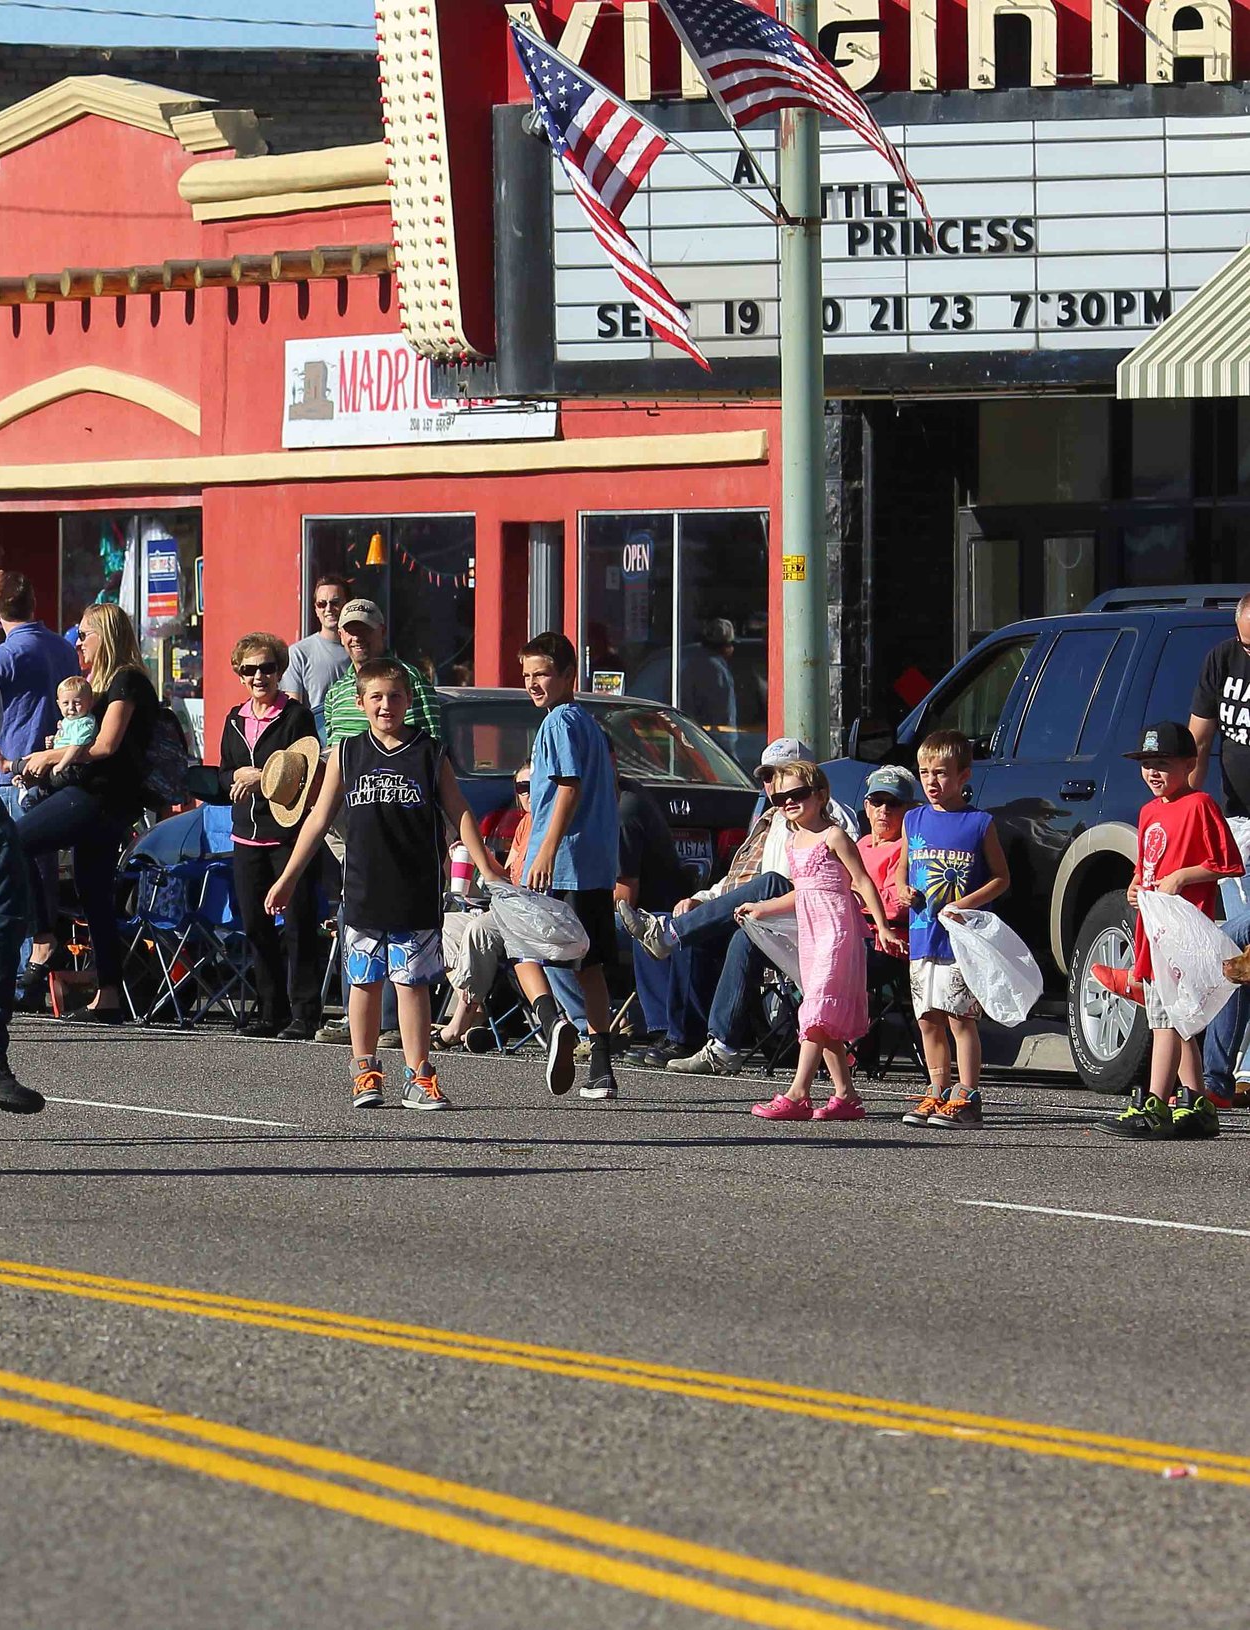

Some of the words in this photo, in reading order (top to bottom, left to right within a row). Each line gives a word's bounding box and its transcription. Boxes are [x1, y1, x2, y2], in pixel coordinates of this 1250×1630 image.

[505, 0, 1232, 102] VIGINIA
[733, 150, 756, 184] A
[821, 184, 908, 218] TTLE
[848, 217, 1036, 256] PRINCESS
[597, 303, 692, 338] SE
[724, 299, 761, 335] 19
[823, 297, 842, 333] 0
[870, 296, 905, 331] 21
[929, 294, 973, 330] 23
[623, 543, 650, 573] OPEN
[350, 788, 421, 807] MULISHA
[359, 774, 409, 792] METAL
[912, 848, 946, 860] BEACH
[947, 849, 975, 863] BUM
